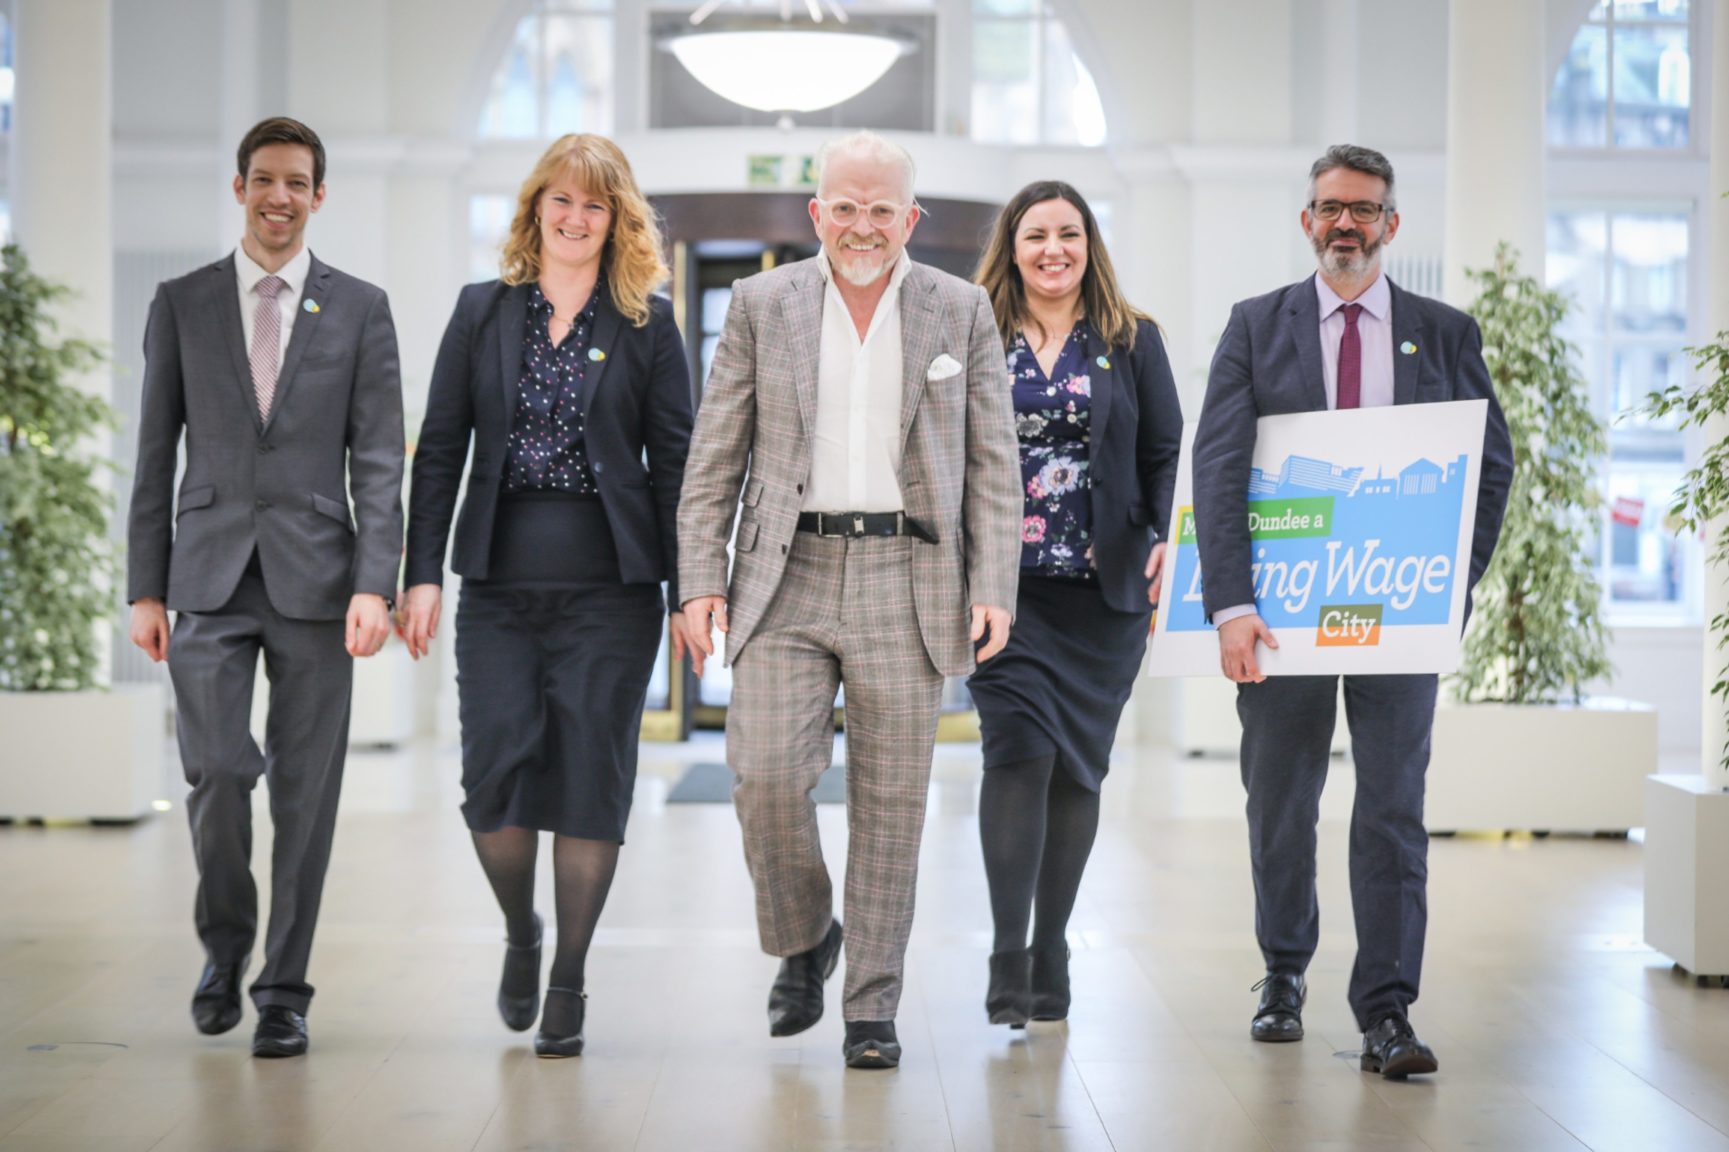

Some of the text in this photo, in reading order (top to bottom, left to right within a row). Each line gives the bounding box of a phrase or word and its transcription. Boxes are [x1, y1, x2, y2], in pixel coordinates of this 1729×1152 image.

[1248, 508, 1324, 531] Dundee a
[1182, 538, 1450, 613] Ling Wage
[1322, 611, 1375, 643] City
